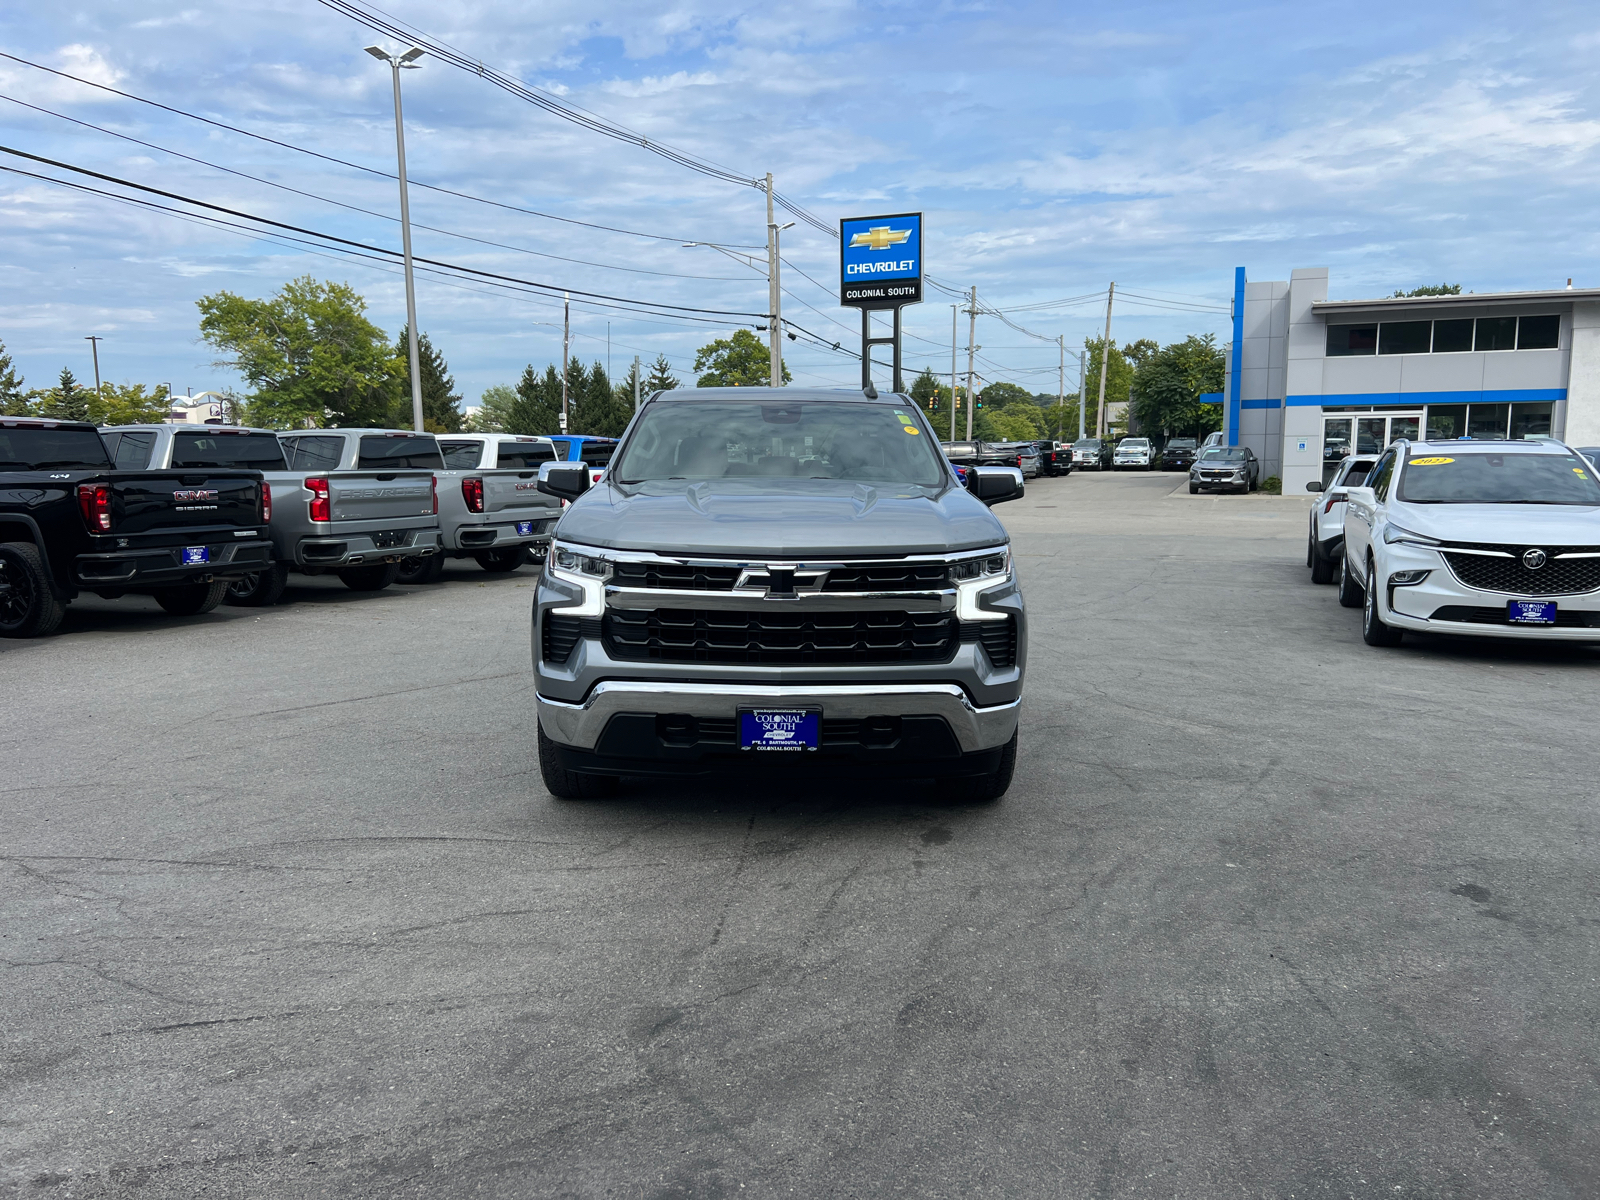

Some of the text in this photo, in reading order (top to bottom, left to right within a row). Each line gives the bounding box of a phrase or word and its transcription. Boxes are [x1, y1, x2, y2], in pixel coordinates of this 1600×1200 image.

[847, 260, 914, 274] CHEVROLET
[846, 287, 915, 298] COLONIAL SOUTH
[173, 490, 218, 501] GMC
[340, 487, 430, 499] CHEVROLET
[755, 714, 803, 723] COLONIAL
[762, 723, 795, 731] SOUTH
